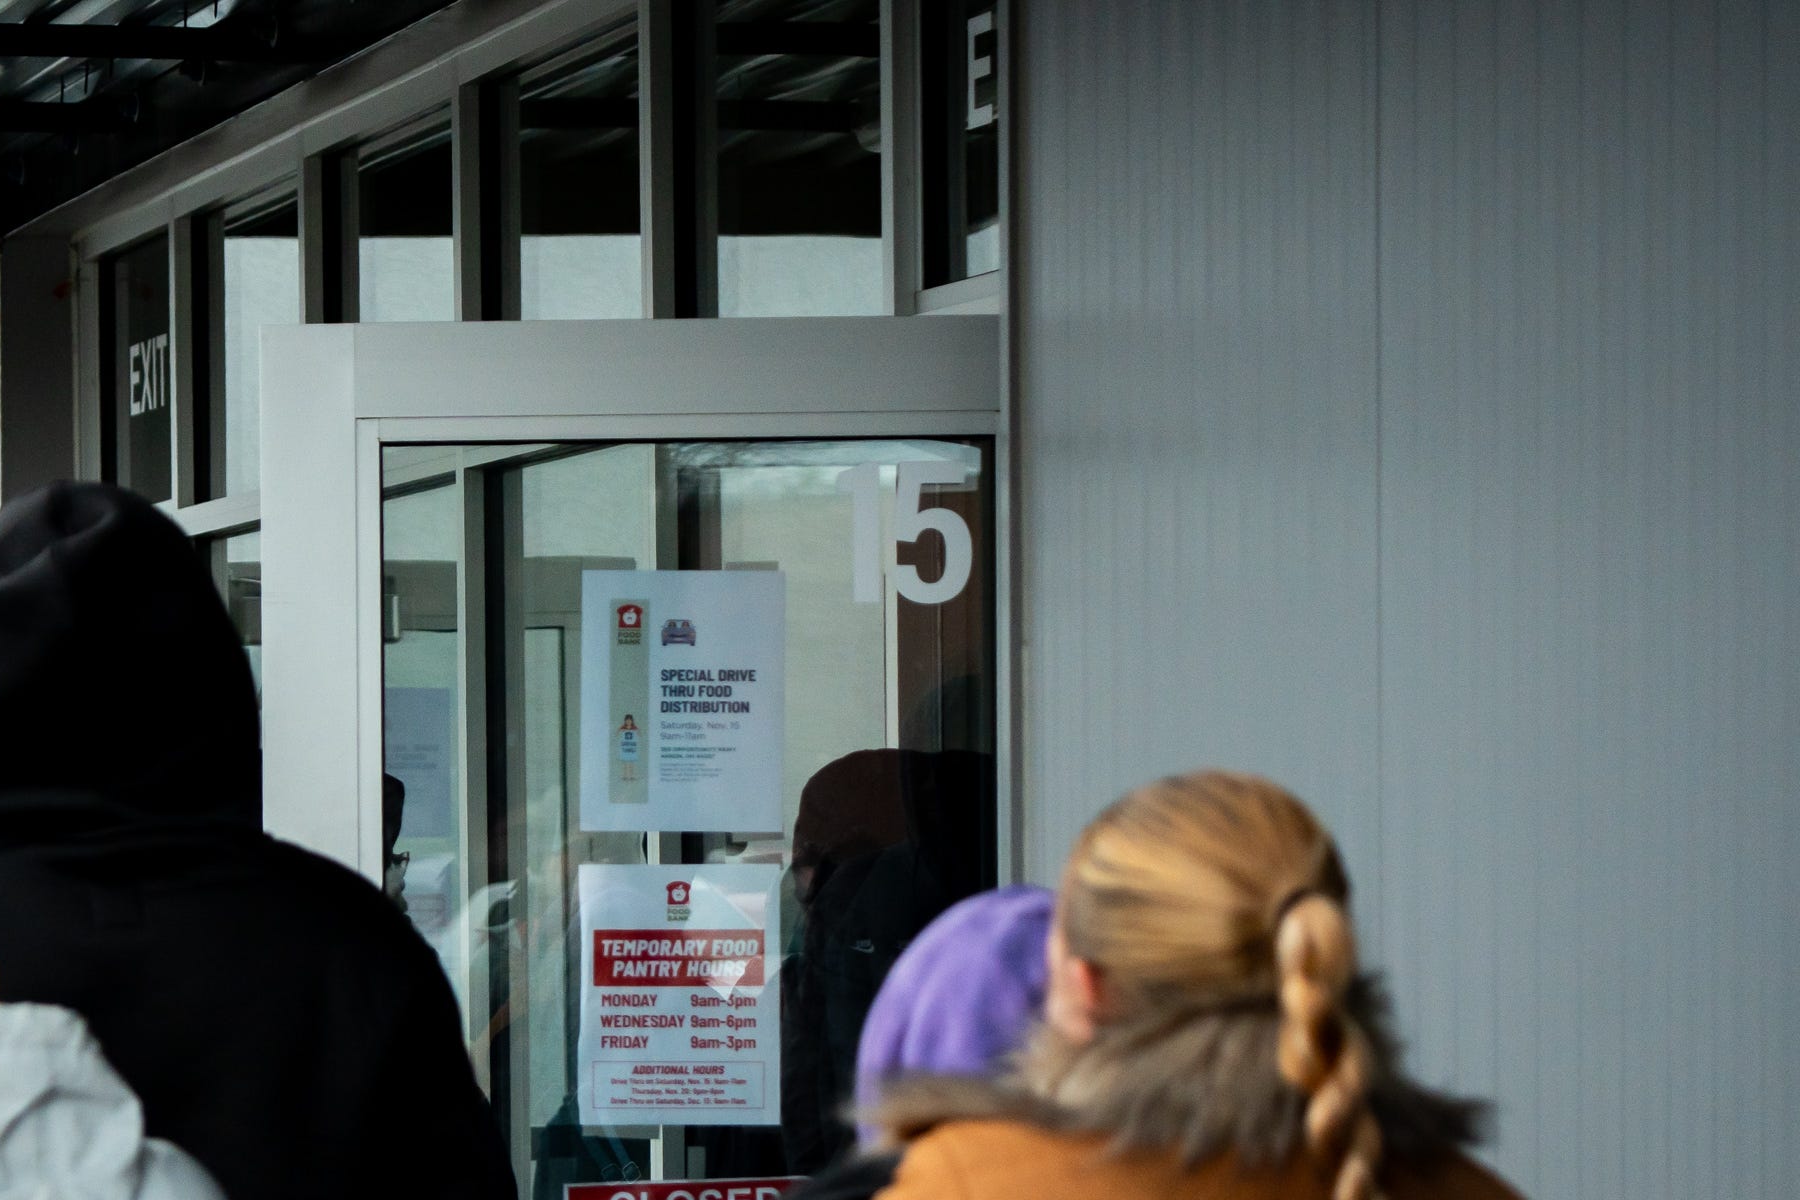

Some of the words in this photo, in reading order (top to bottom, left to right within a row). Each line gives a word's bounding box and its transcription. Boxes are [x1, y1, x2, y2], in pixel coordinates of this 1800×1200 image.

[967, 11, 993, 130] E
[129, 333, 167, 416] EXIT
[835, 460, 973, 605] 15
[660, 669, 715, 682] SPECIAL
[718, 669, 757, 682] DRIVE
[660, 685, 695, 698] THRU
[698, 685, 733, 698] FOOD
[660, 700, 751, 714] DISTRIBUTION
[601, 939, 707, 957] TEMPORARY
[711, 939, 760, 957] FOOD
[612, 960, 683, 977] PANTRY
[686, 960, 747, 978] HOURS
[601, 994, 658, 1007] MONDAY
[690, 994, 757, 1010] 9am-3pm
[600, 1015, 686, 1028] WEDNESDAY
[690, 1015, 757, 1030] 9am-6pm
[601, 1036, 649, 1049] FRIDAY
[690, 1036, 757, 1051] 9am-3pm
[631, 1065, 690, 1075] ADDITIONAL
[692, 1065, 725, 1075] HOURS
